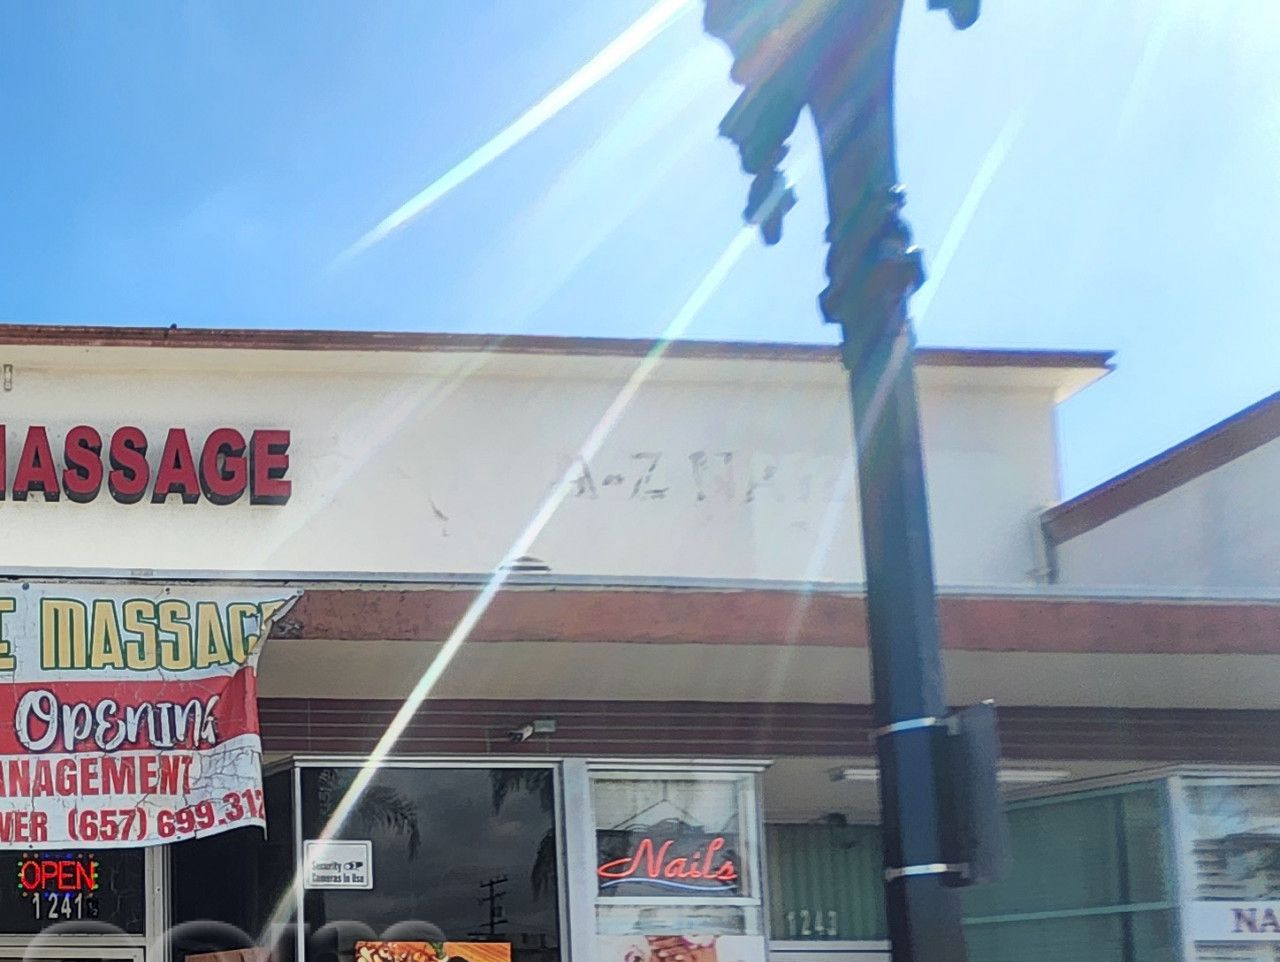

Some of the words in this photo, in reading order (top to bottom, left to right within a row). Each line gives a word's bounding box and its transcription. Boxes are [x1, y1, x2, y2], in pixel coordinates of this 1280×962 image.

[67, 807, 148, 842] (657)
[20, 860, 95, 890] OPEN
[596, 837, 738, 882] Nails
[32, 892, 83, 919] 1241
